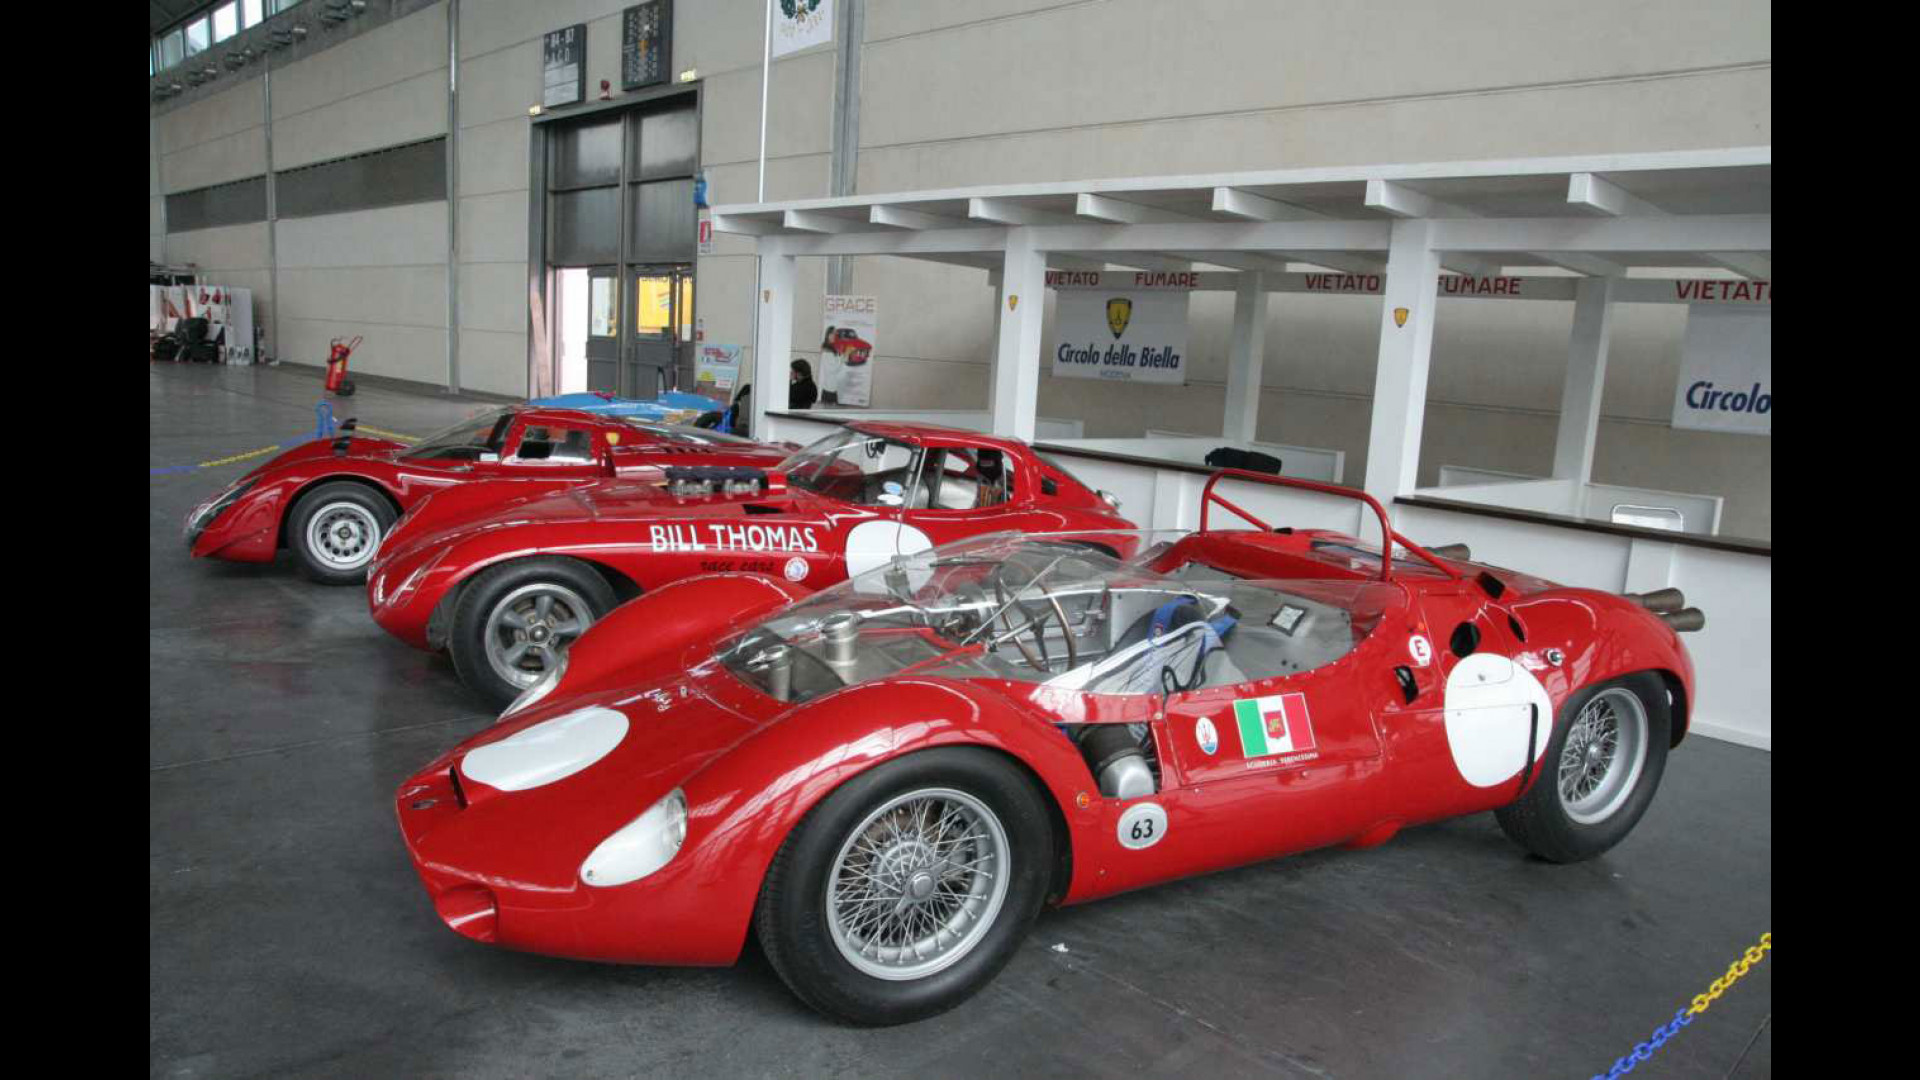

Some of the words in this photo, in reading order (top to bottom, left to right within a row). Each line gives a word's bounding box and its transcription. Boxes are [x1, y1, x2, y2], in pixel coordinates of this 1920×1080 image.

[1045, 271, 1099, 286] VIETATO
[1136, 272, 1199, 287] FUMARE
[1305, 273, 1380, 291] VIETATO
[1675, 279, 1771, 301] VIETAT
[825, 297, 876, 313] GRACE
[1057, 342, 1099, 364] Circolo
[1103, 344, 1135, 367] della
[1139, 346, 1180, 369] Biella
[1686, 380, 1771, 414] Circolo
[650, 524, 706, 553] BILL
[709, 524, 817, 552] THOMAS
[1413, 639, 1427, 657] E
[1131, 818, 1154, 840] 63
